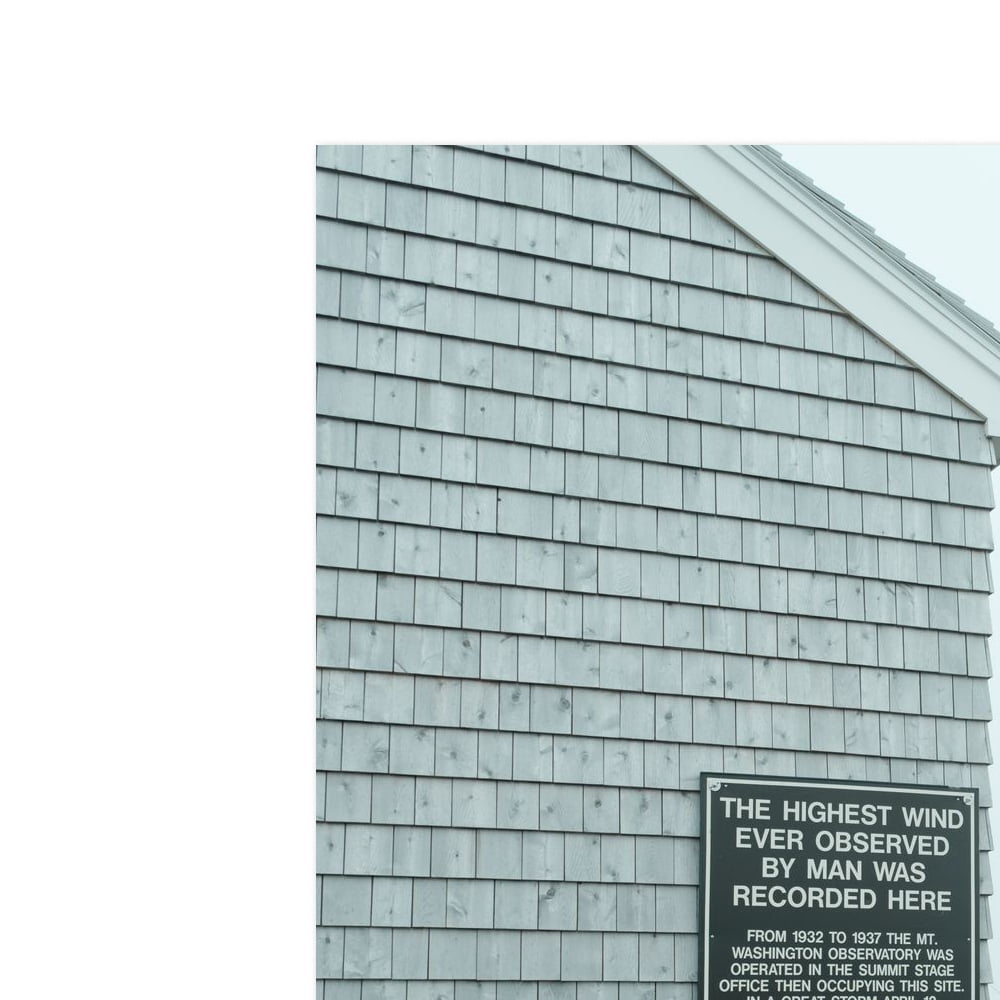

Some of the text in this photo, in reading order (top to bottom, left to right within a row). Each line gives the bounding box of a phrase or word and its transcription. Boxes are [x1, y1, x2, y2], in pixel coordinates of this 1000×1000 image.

[720, 797, 964, 829] THE HIGHEST WIND
[736, 827, 949, 856] EVER OBSERVED
[762, 857, 926, 883] BY MAN WAS
[733, 885, 951, 911] RECORDED HERE
[747, 930, 938, 945] FROM 1932 TO 1937 THE MT.
[732, 946, 953, 961] WASHINGTON OBSERVATORY WAS
[731, 963, 954, 976] OPERATED IN THE SUMMIT STAGE
[719, 979, 964, 992] OFFICE THEN OCCUPYING THIS SITE.
